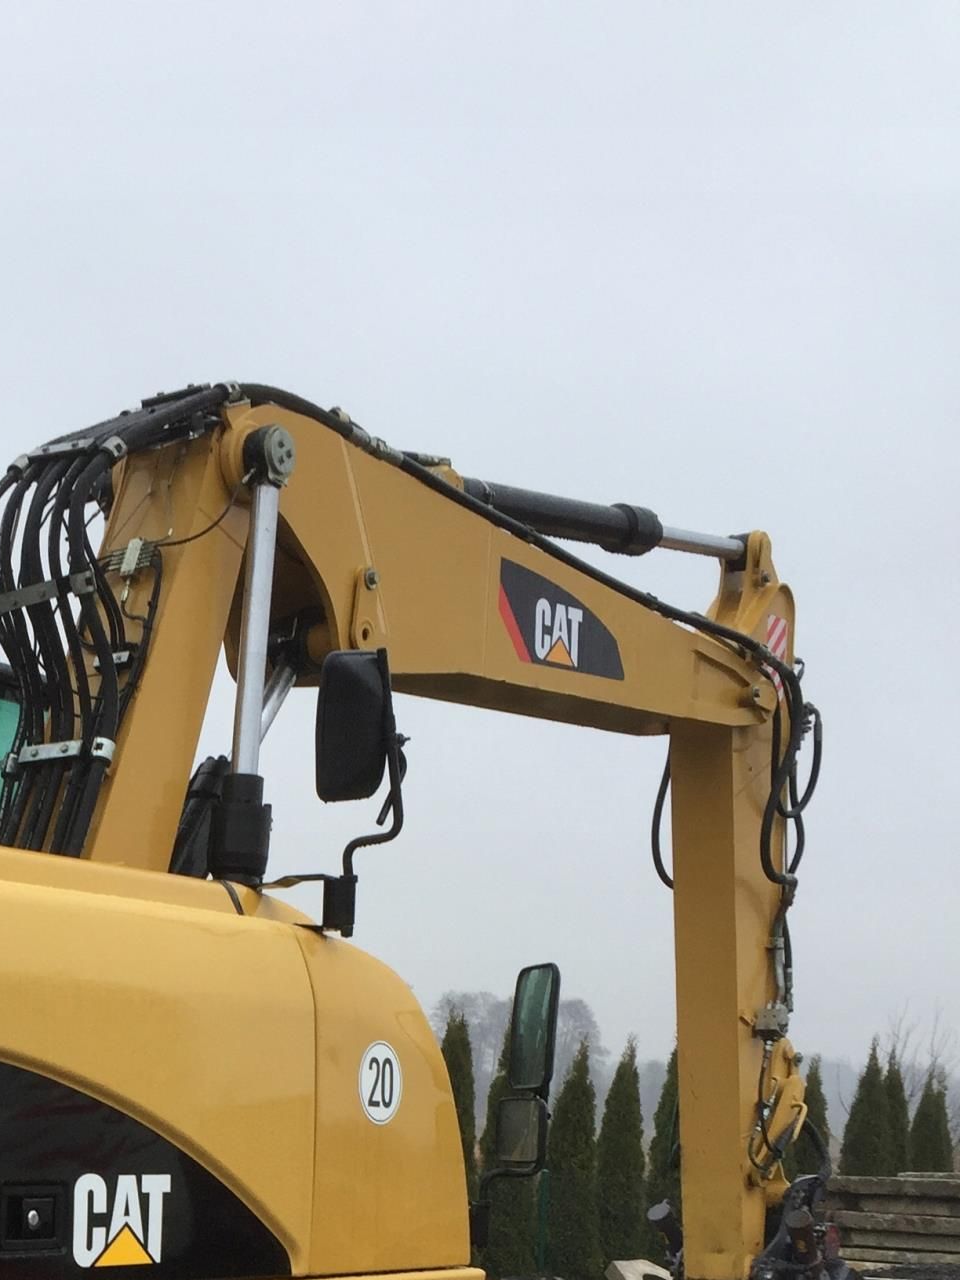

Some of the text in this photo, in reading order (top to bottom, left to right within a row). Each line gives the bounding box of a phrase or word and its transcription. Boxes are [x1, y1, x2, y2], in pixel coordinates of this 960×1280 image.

[535, 598, 584, 667] CAT
[367, 1057, 394, 1109] 20
[72, 1173, 172, 1268] CAT
